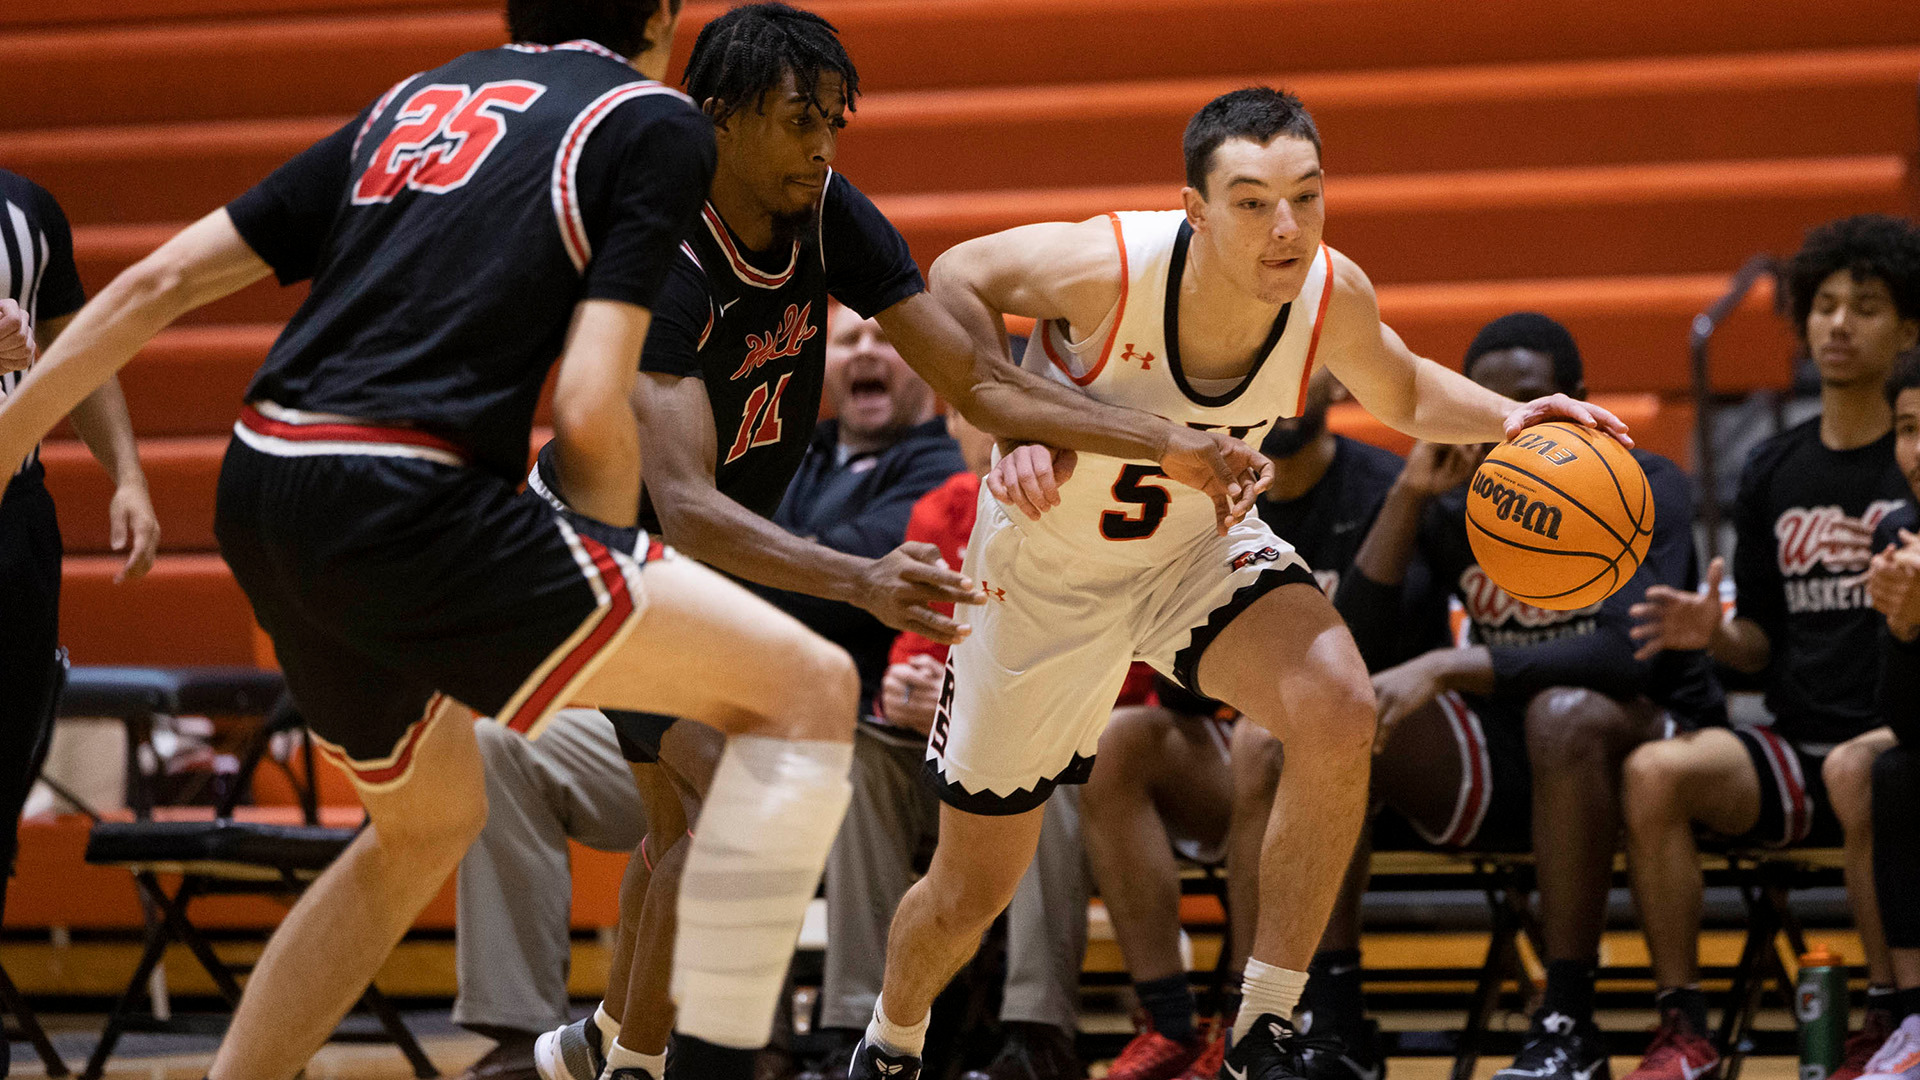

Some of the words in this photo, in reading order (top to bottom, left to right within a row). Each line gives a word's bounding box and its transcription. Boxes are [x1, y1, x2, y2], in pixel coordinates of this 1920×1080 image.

[351, 80, 548, 206] 25
[723, 371, 794, 466] 11
[1099, 463, 1173, 541] 5
[1472, 470, 1562, 540] Wilson
